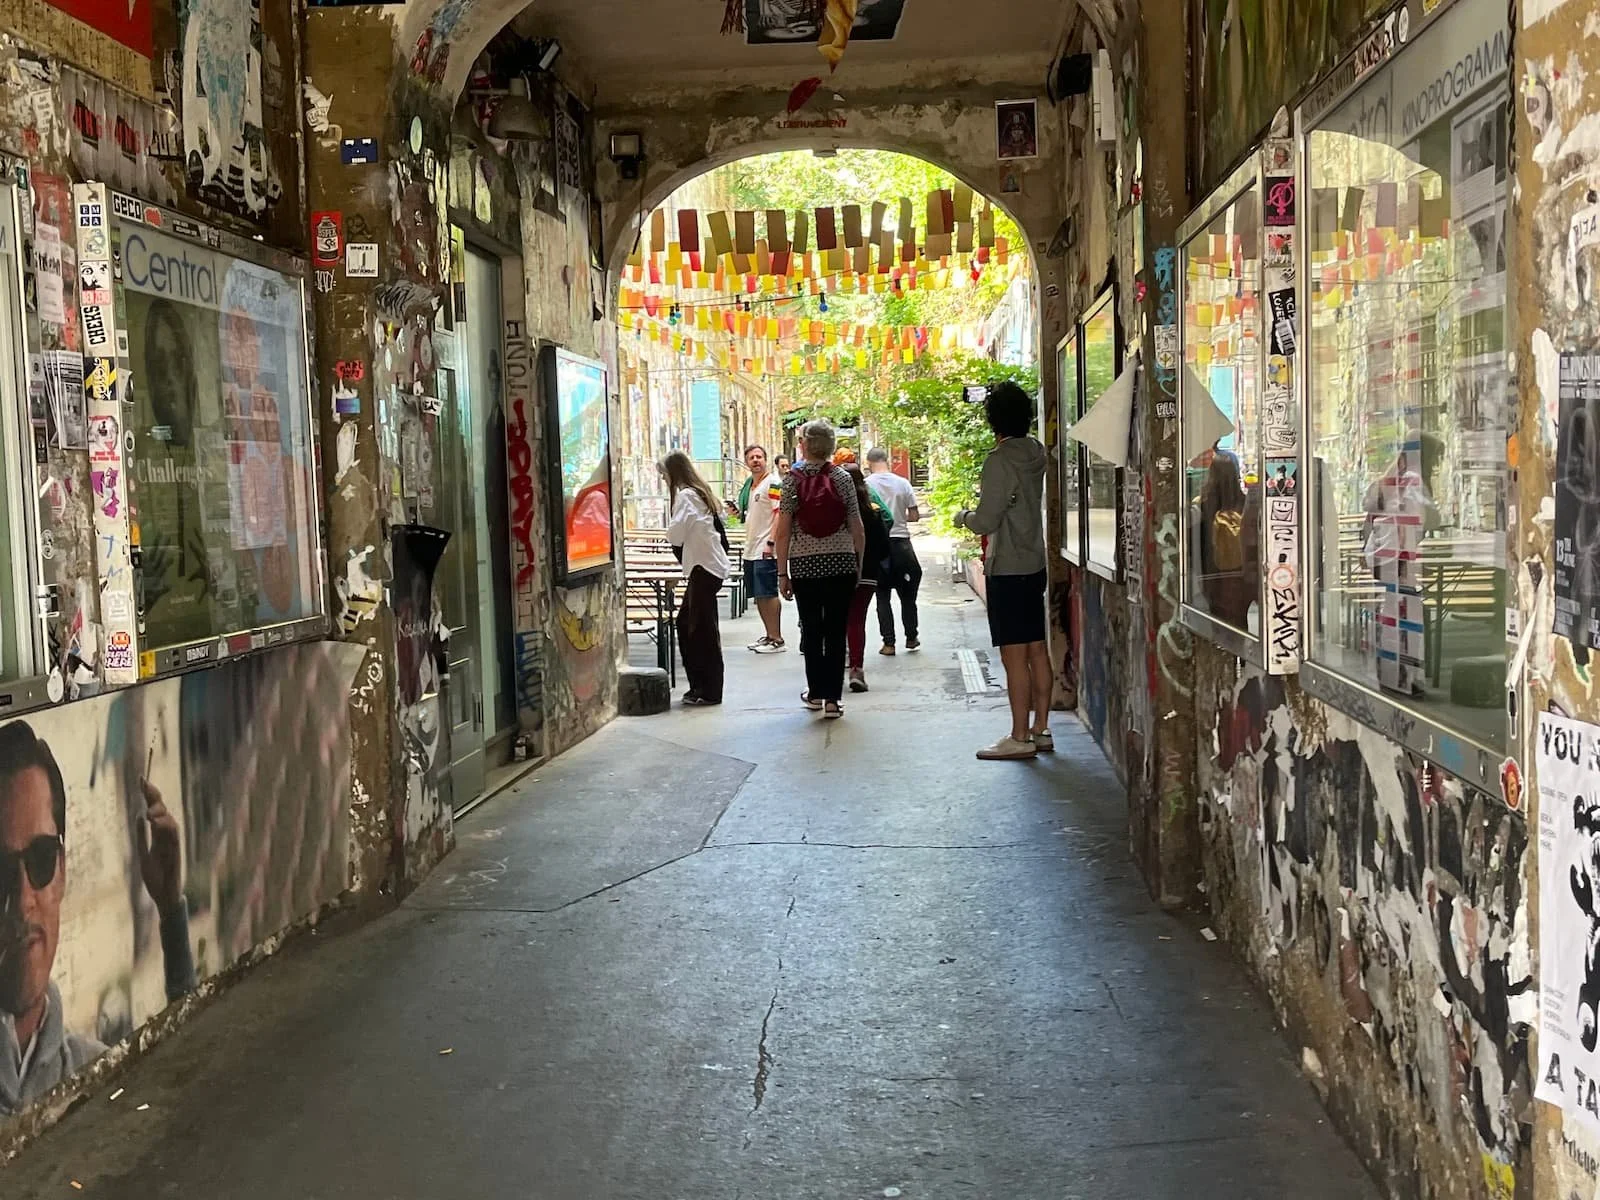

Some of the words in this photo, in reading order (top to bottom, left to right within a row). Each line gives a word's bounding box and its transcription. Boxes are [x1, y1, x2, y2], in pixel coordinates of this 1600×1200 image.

[126, 234, 218, 305] Central
[137, 457, 213, 489] Challengers
[1542, 722, 1581, 766] YOU
[1544, 1052, 1565, 1093] A
[1574, 1066, 1600, 1120] TA
